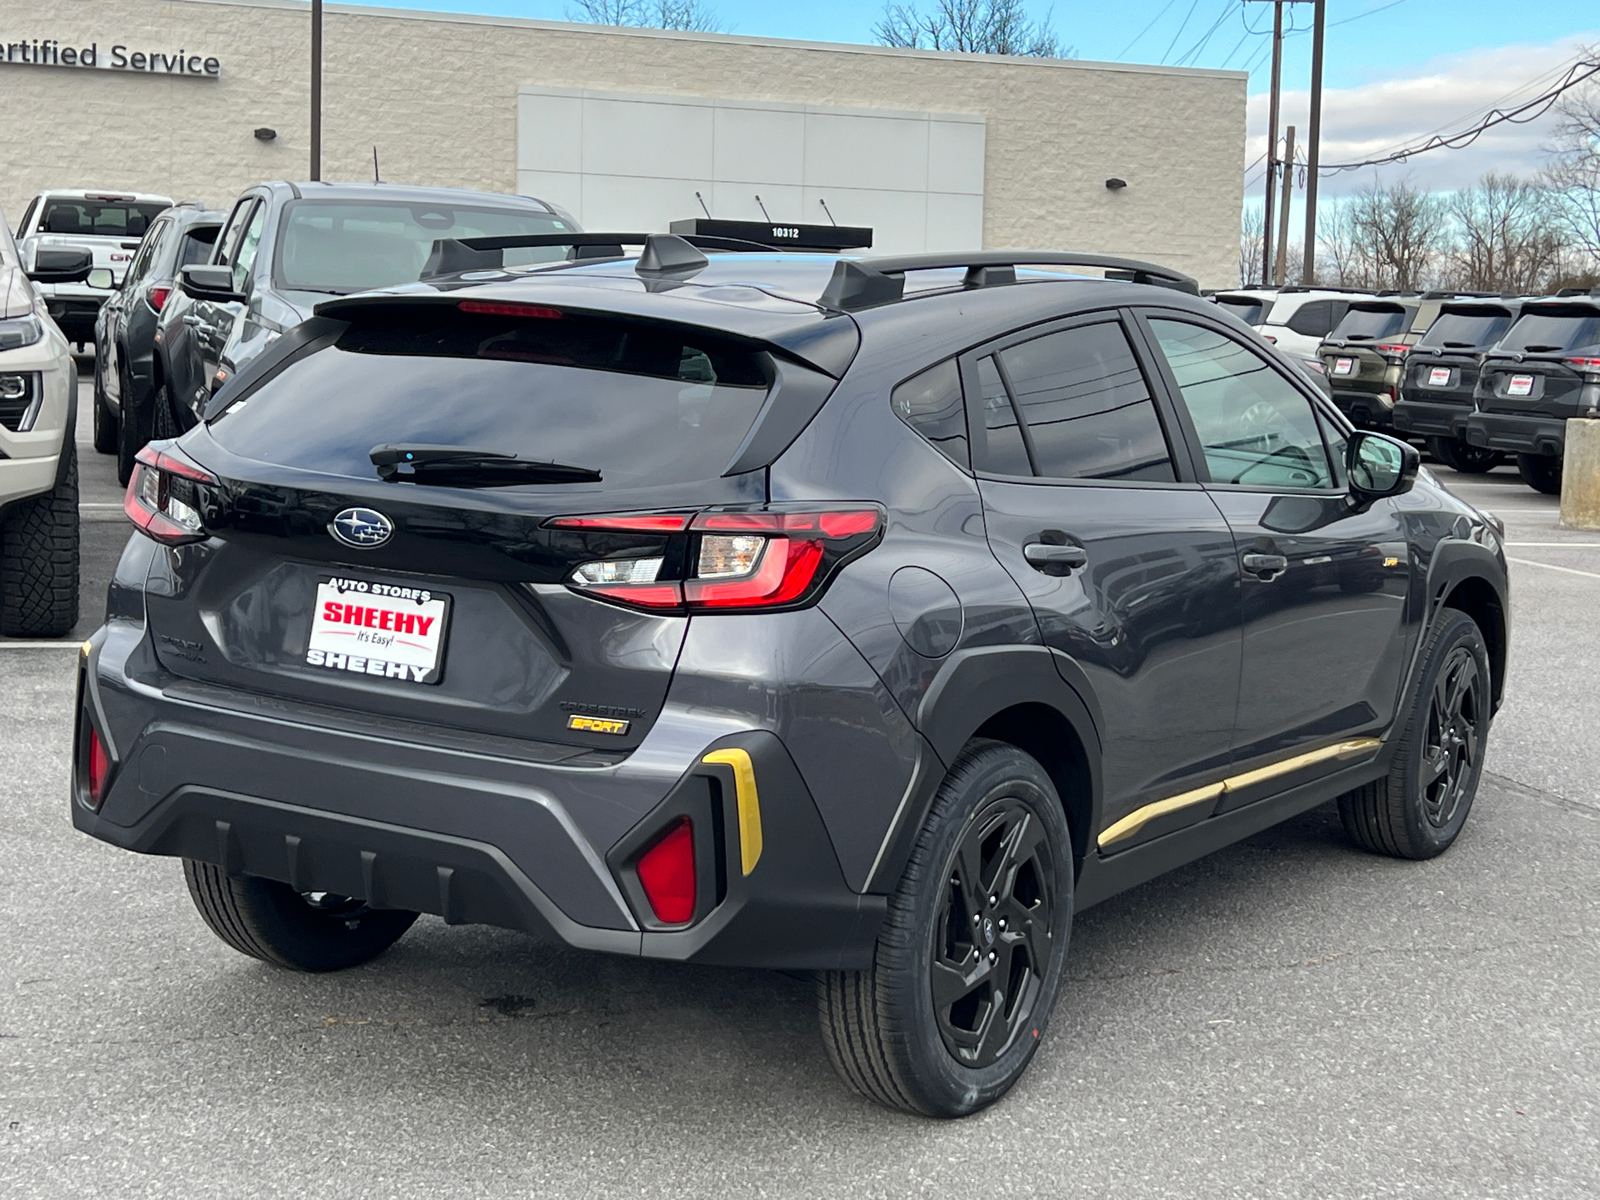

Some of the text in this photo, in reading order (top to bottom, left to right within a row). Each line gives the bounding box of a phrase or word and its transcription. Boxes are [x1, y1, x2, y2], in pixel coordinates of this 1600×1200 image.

[111, 45, 220, 74] Service
[772, 227, 799, 238] 10312
[328, 578, 431, 601] AUTO STORES
[323, 601, 435, 637] SHEEHY
[357, 630, 395, 649] It's Easy!
[306, 649, 433, 683] SHEEHY
[559, 700, 648, 718] CROSSTREK
[570, 718, 624, 733] SPORT
